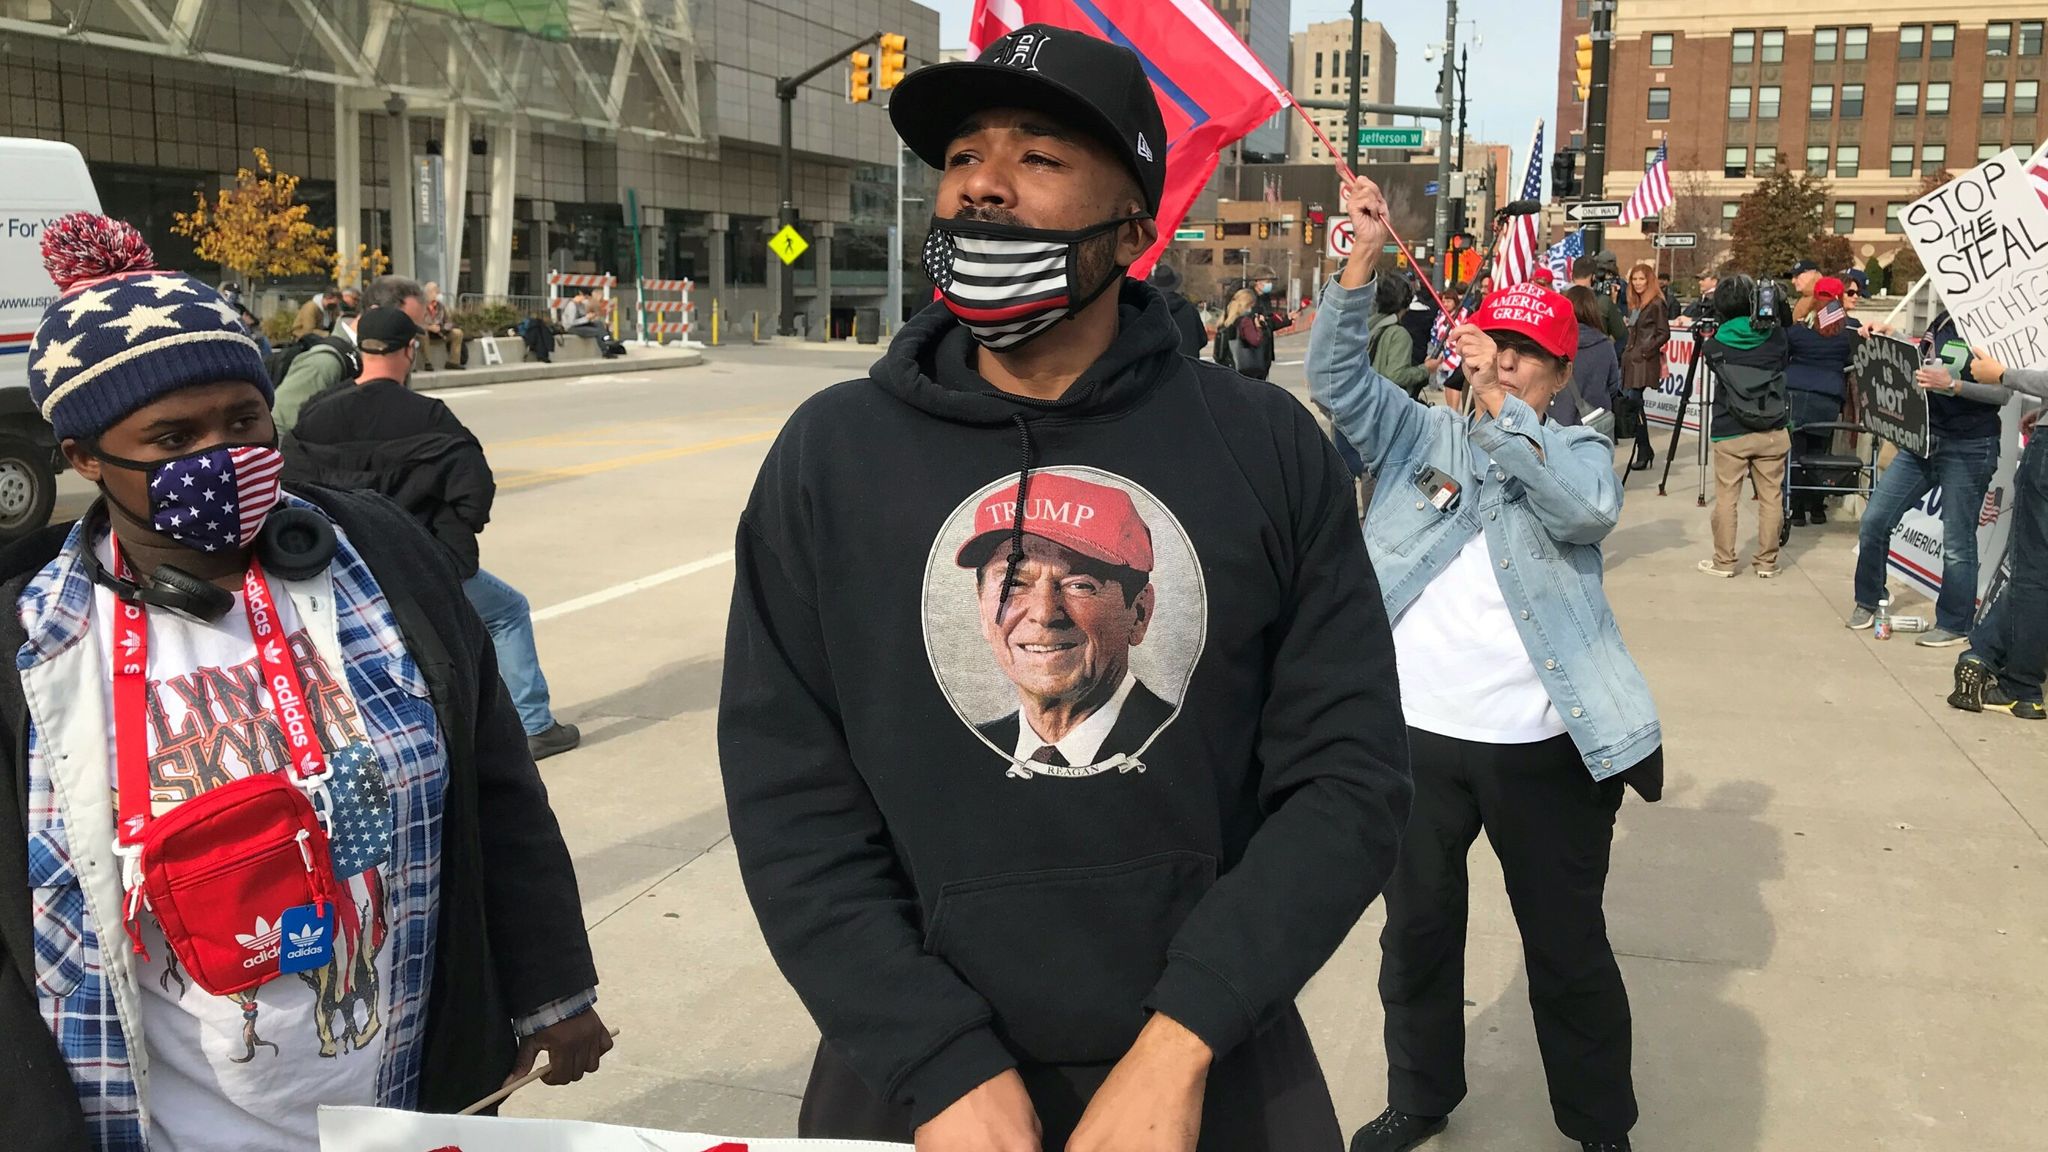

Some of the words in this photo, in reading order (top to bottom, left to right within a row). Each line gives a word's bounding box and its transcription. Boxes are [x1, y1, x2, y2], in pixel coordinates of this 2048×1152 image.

[1360, 132, 1407, 144] Jefferson
[1410, 133, 1420, 144] W
[1600, 207, 1617, 215] WAY
[1907, 162, 2006, 244] STOP
[8, 218, 38, 238] For
[1945, 209, 1996, 250] THE
[1936, 217, 2048, 295] STEAL
[1507, 282, 1546, 299] KEEP
[1488, 295, 1555, 318] AMERICA
[1493, 307, 1543, 326] GREAT
[1957, 270, 2048, 347] MICHIG
[1656, 401, 1679, 414] AMERIC
[986, 498, 1095, 528] TRUMP
[1901, 529, 1943, 560] AMERICA
[245, 568, 272, 638] adidas
[272, 674, 309, 748] adidas
[1047, 765, 1100, 777] REAGAN
[243, 945, 281, 969] adid
[287, 945, 323, 959] adidas
